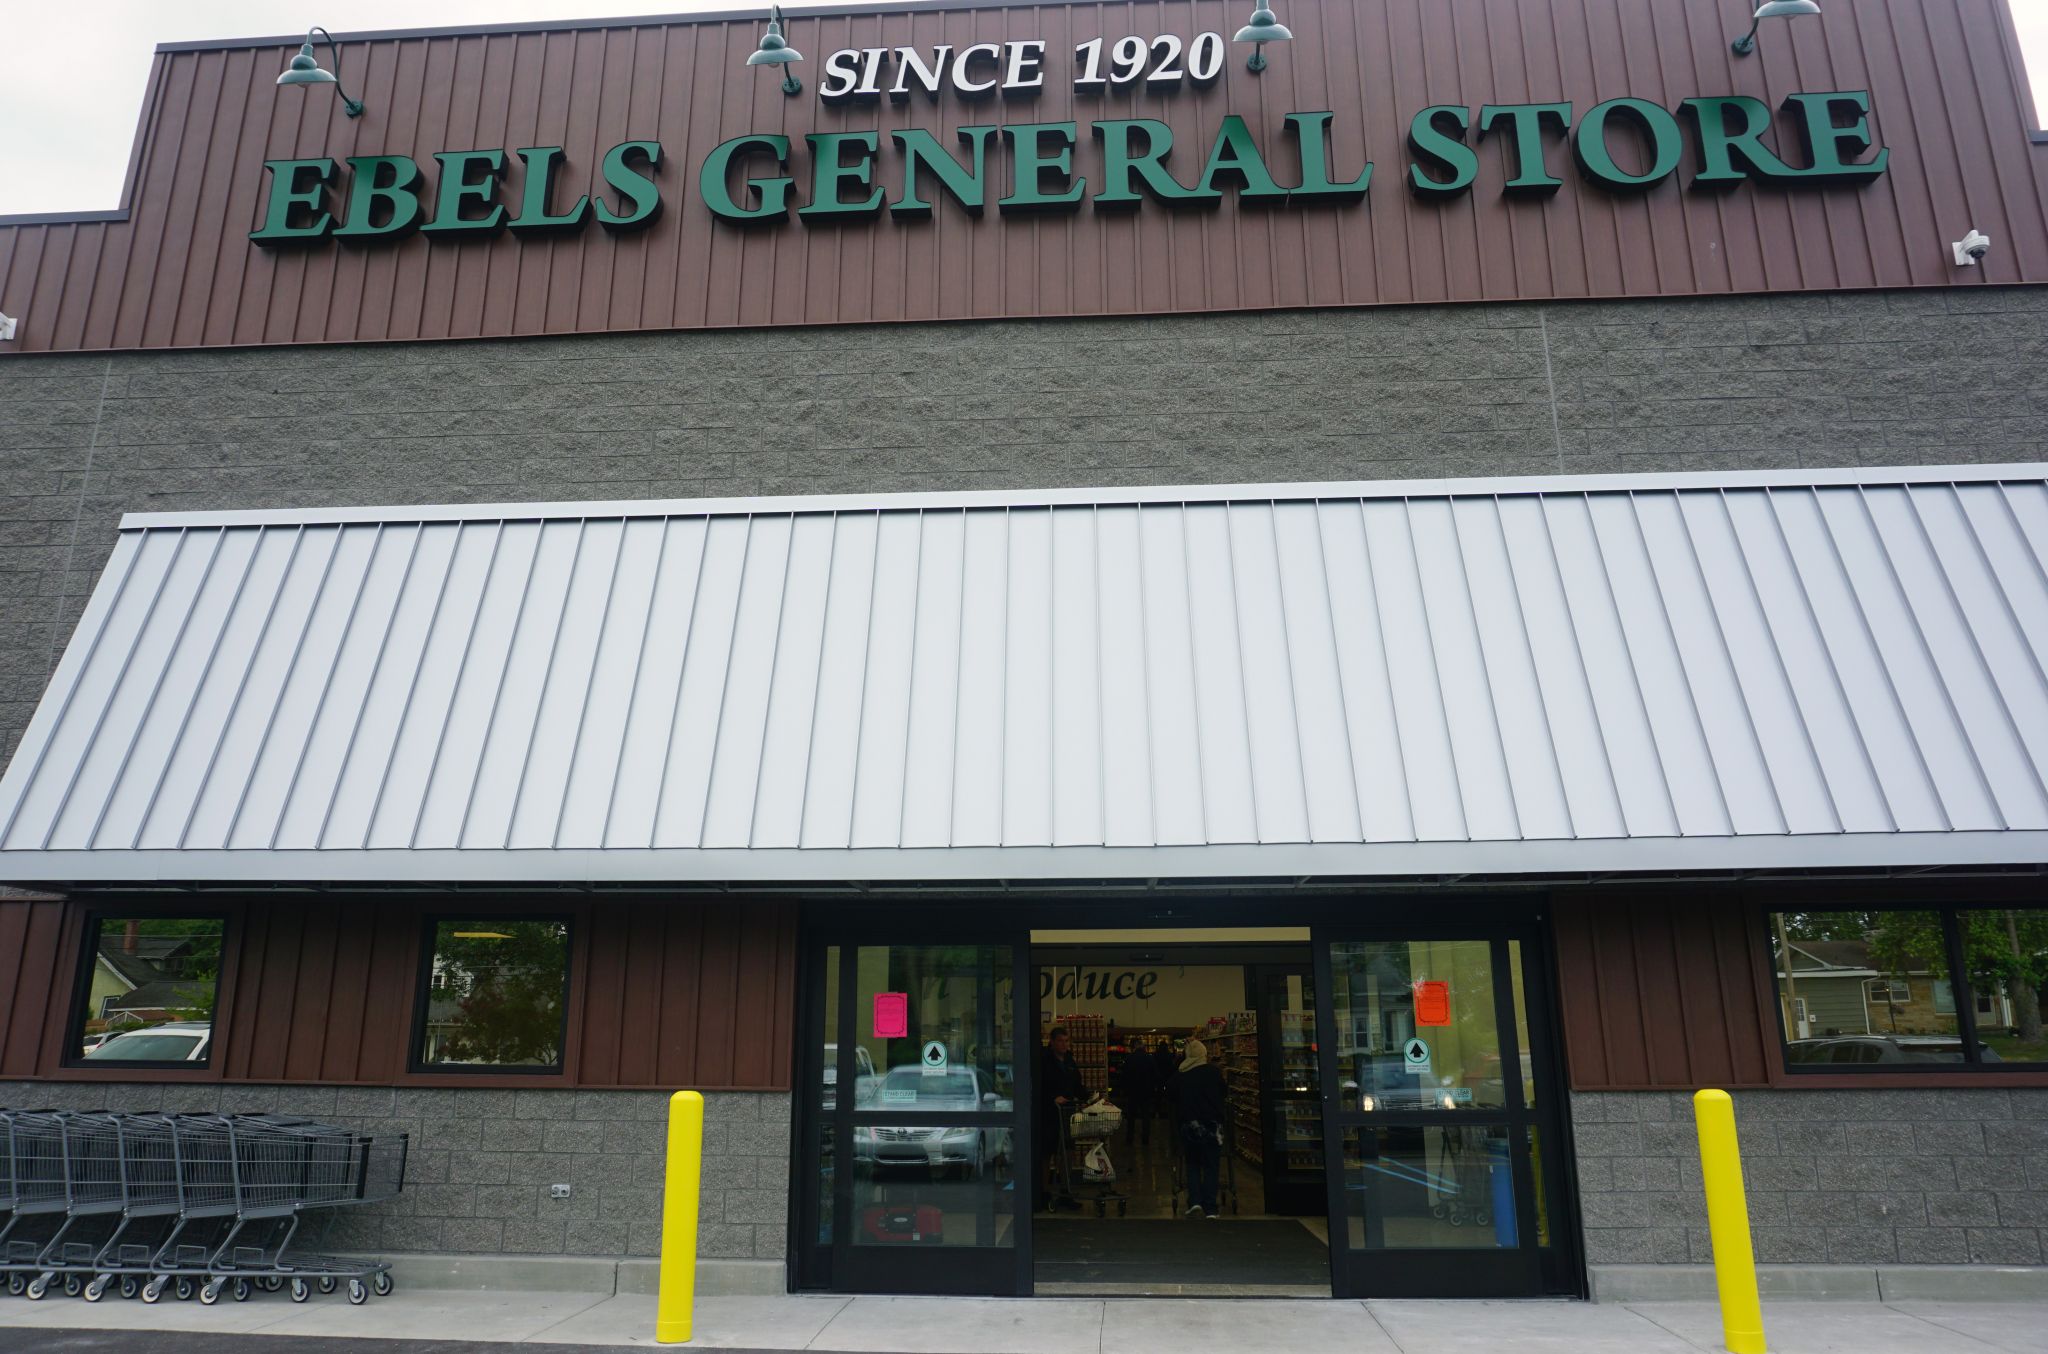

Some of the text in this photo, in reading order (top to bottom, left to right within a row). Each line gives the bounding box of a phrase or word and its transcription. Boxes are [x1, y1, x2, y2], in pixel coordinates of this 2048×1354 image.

[819, 32, 1225, 100] SINCE 1920
[248, 90, 1890, 244] EBELS GENERAL STORE
